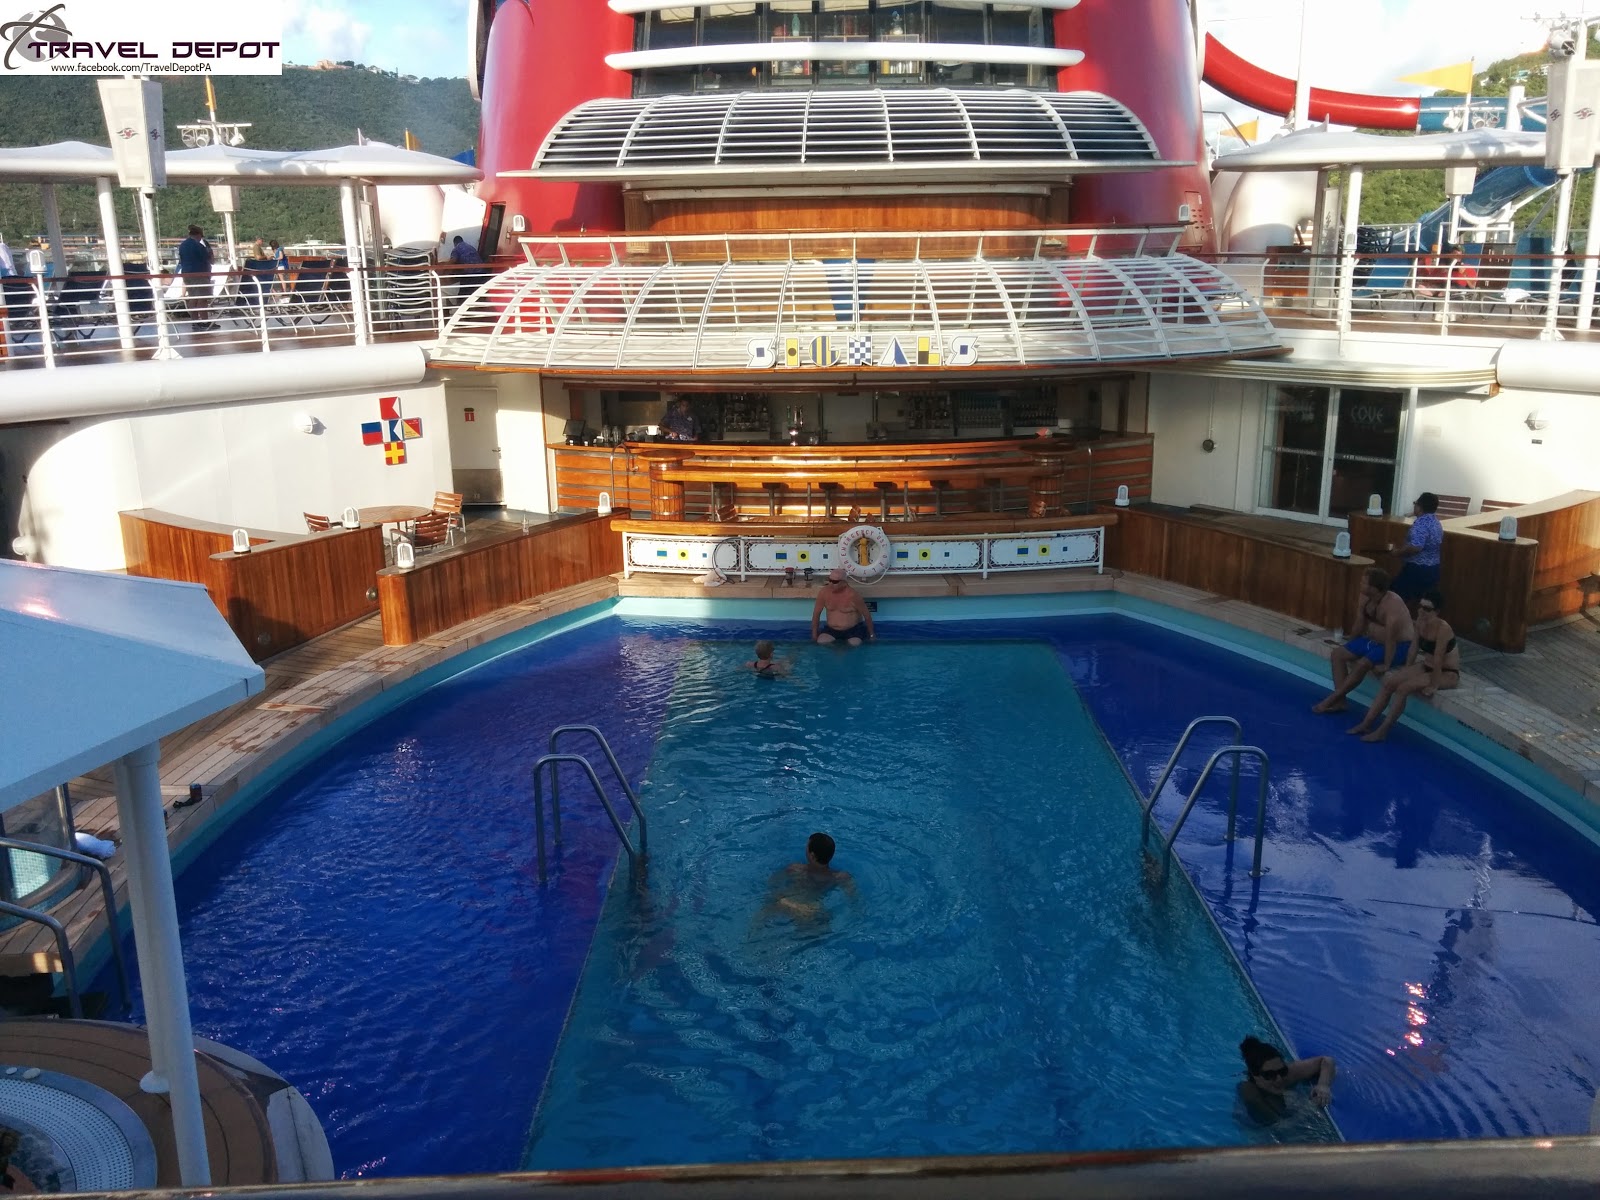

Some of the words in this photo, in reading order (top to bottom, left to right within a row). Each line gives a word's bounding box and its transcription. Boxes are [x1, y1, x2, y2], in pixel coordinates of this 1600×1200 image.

[747, 335, 978, 368] SIGNALS
[841, 530, 874, 557] EMERGENCY
[844, 560, 856, 573] FOR
[863, 554, 888, 575] ONLY
